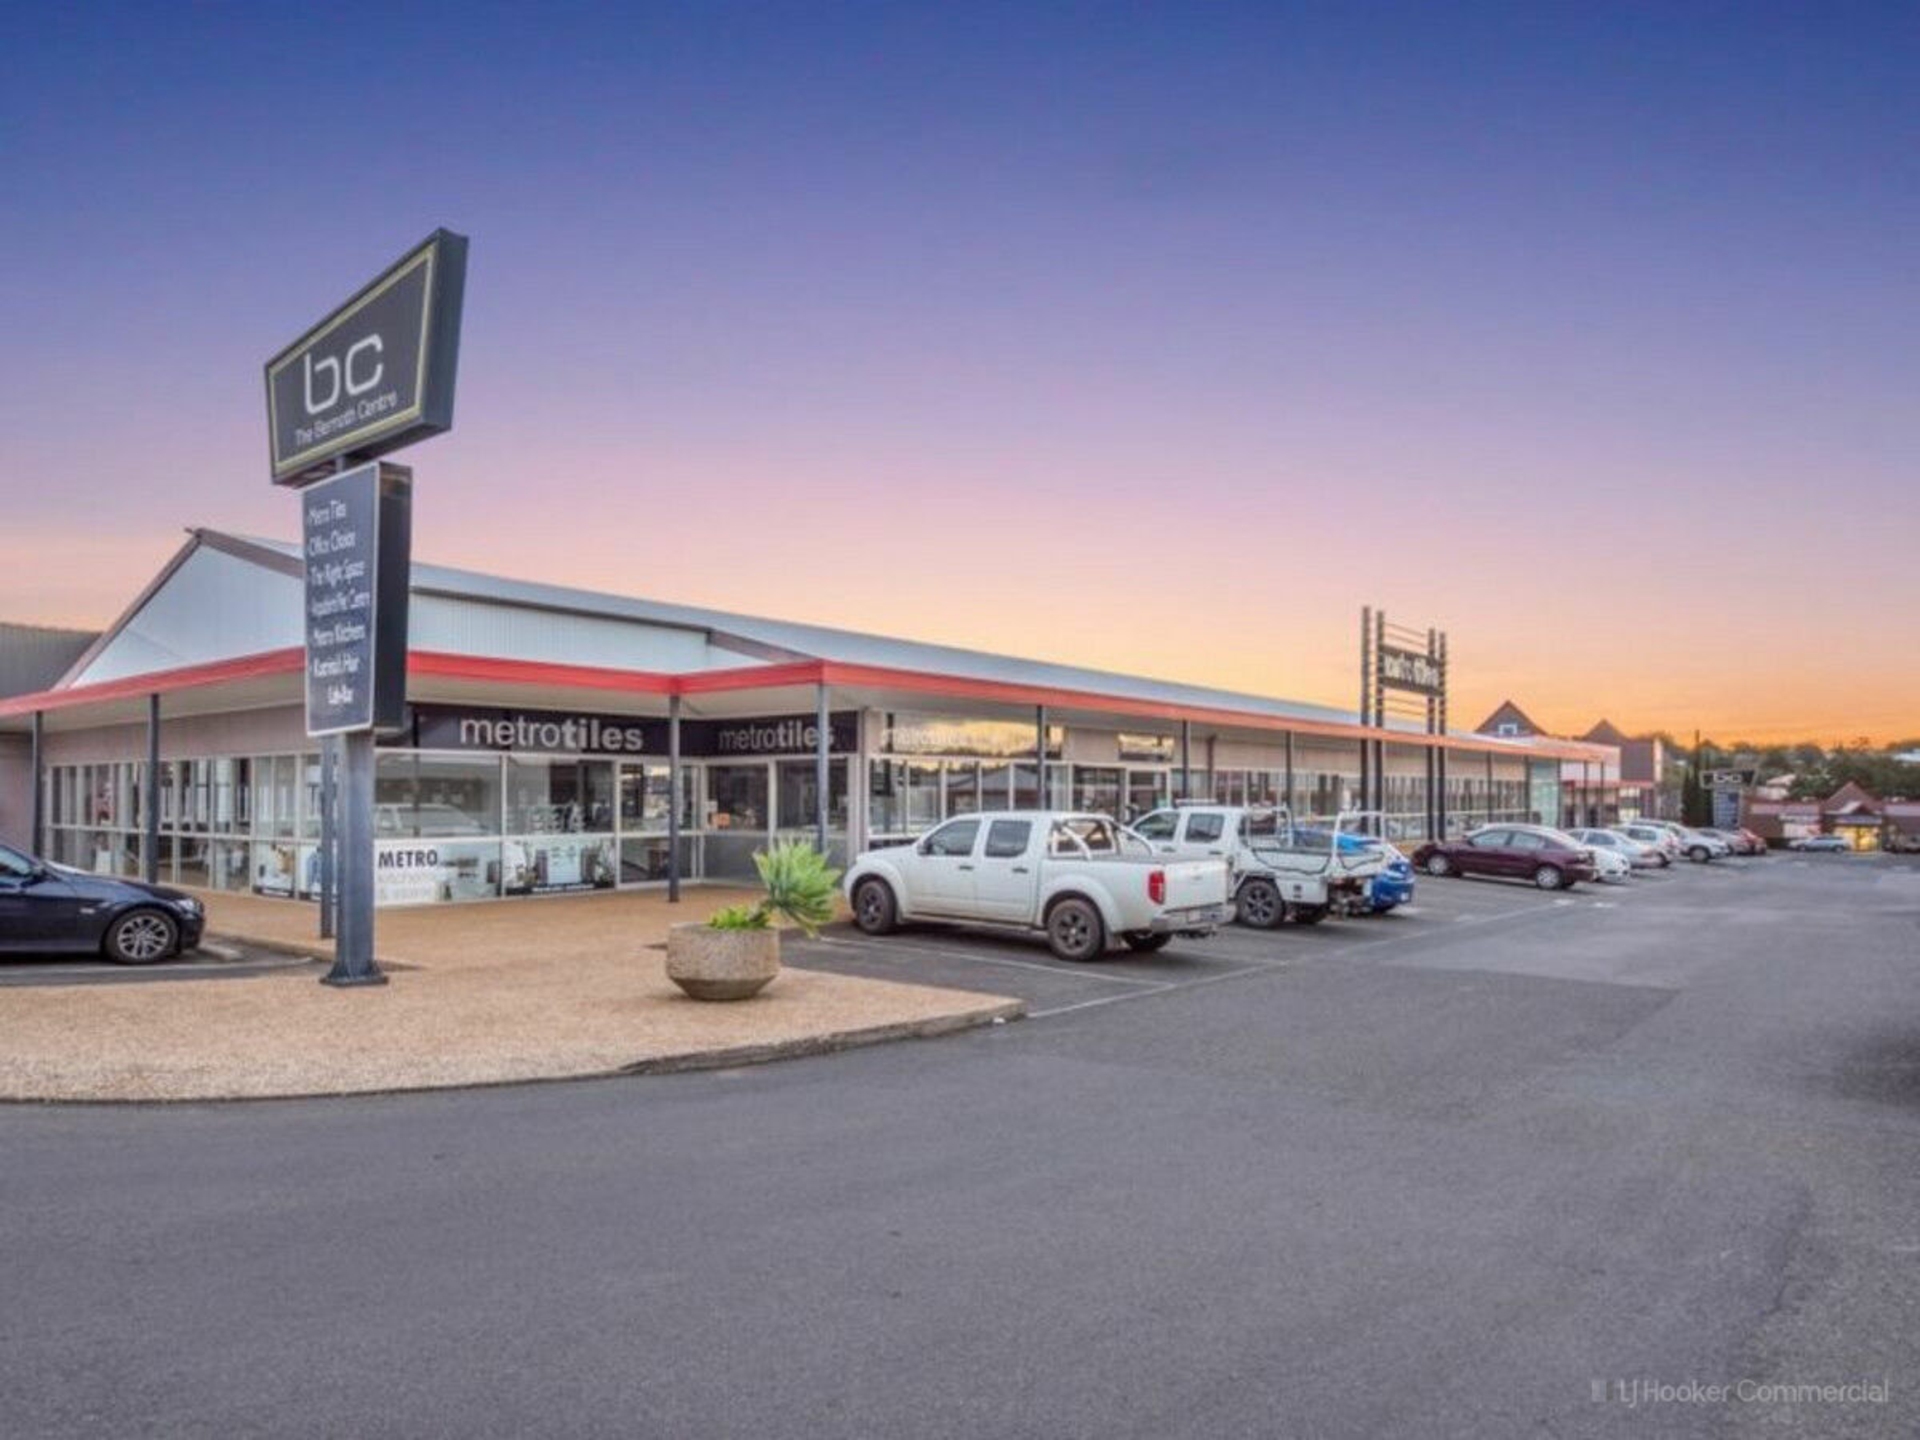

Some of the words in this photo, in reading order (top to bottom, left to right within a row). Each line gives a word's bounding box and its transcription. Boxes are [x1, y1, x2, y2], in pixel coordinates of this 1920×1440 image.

[304, 333, 383, 415] bc
[460, 715, 643, 751] metrotiles
[378, 848, 438, 869] METRO
